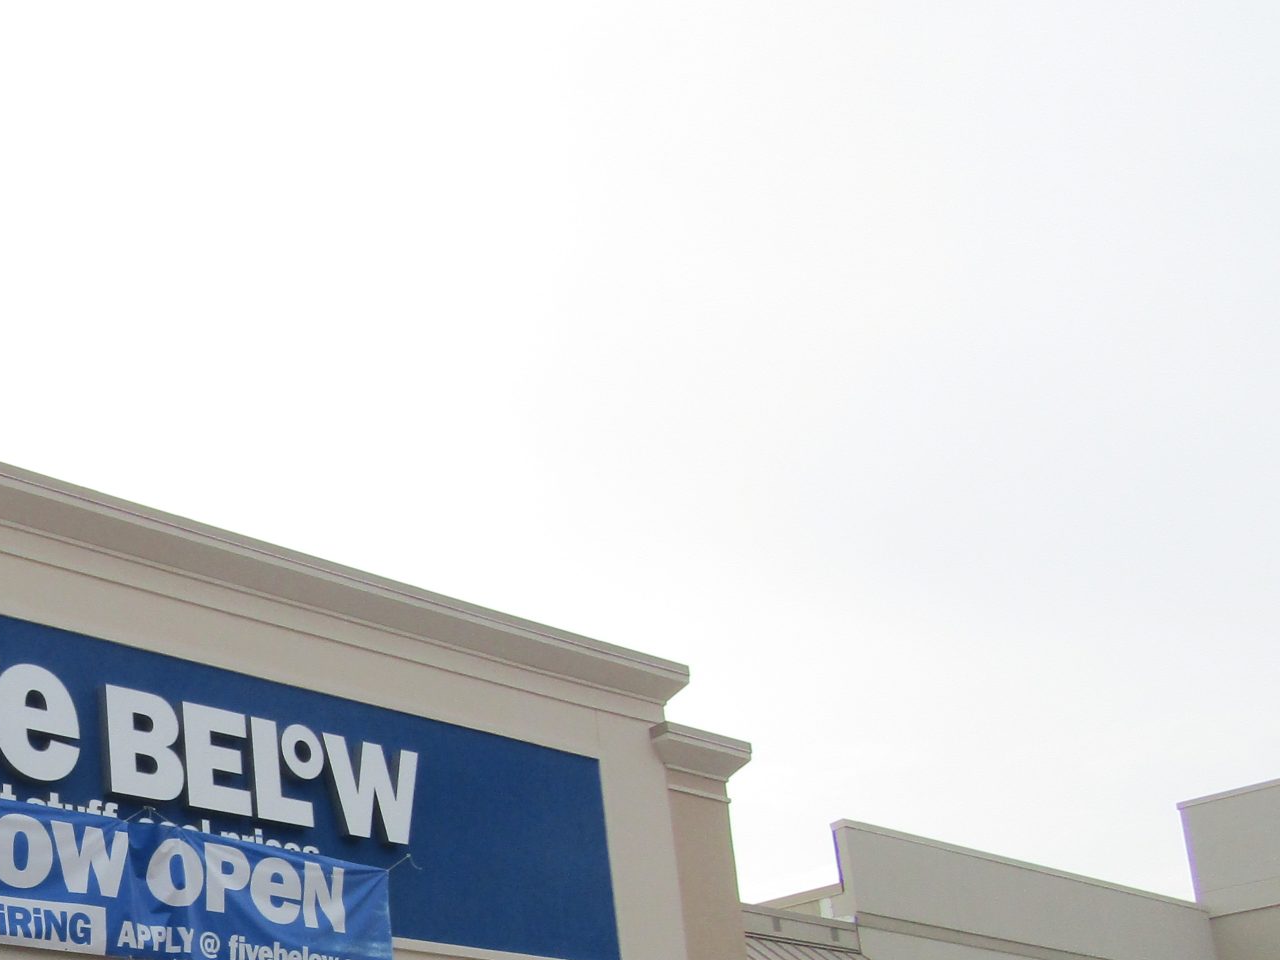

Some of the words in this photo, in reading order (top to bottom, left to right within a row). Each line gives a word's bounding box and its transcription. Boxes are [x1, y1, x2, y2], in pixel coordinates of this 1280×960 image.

[104, 684, 418, 845] BELOW
[146, 838, 346, 933] OPeN
[117, 920, 195, 953] APPLY
[199, 931, 220, 957] @
